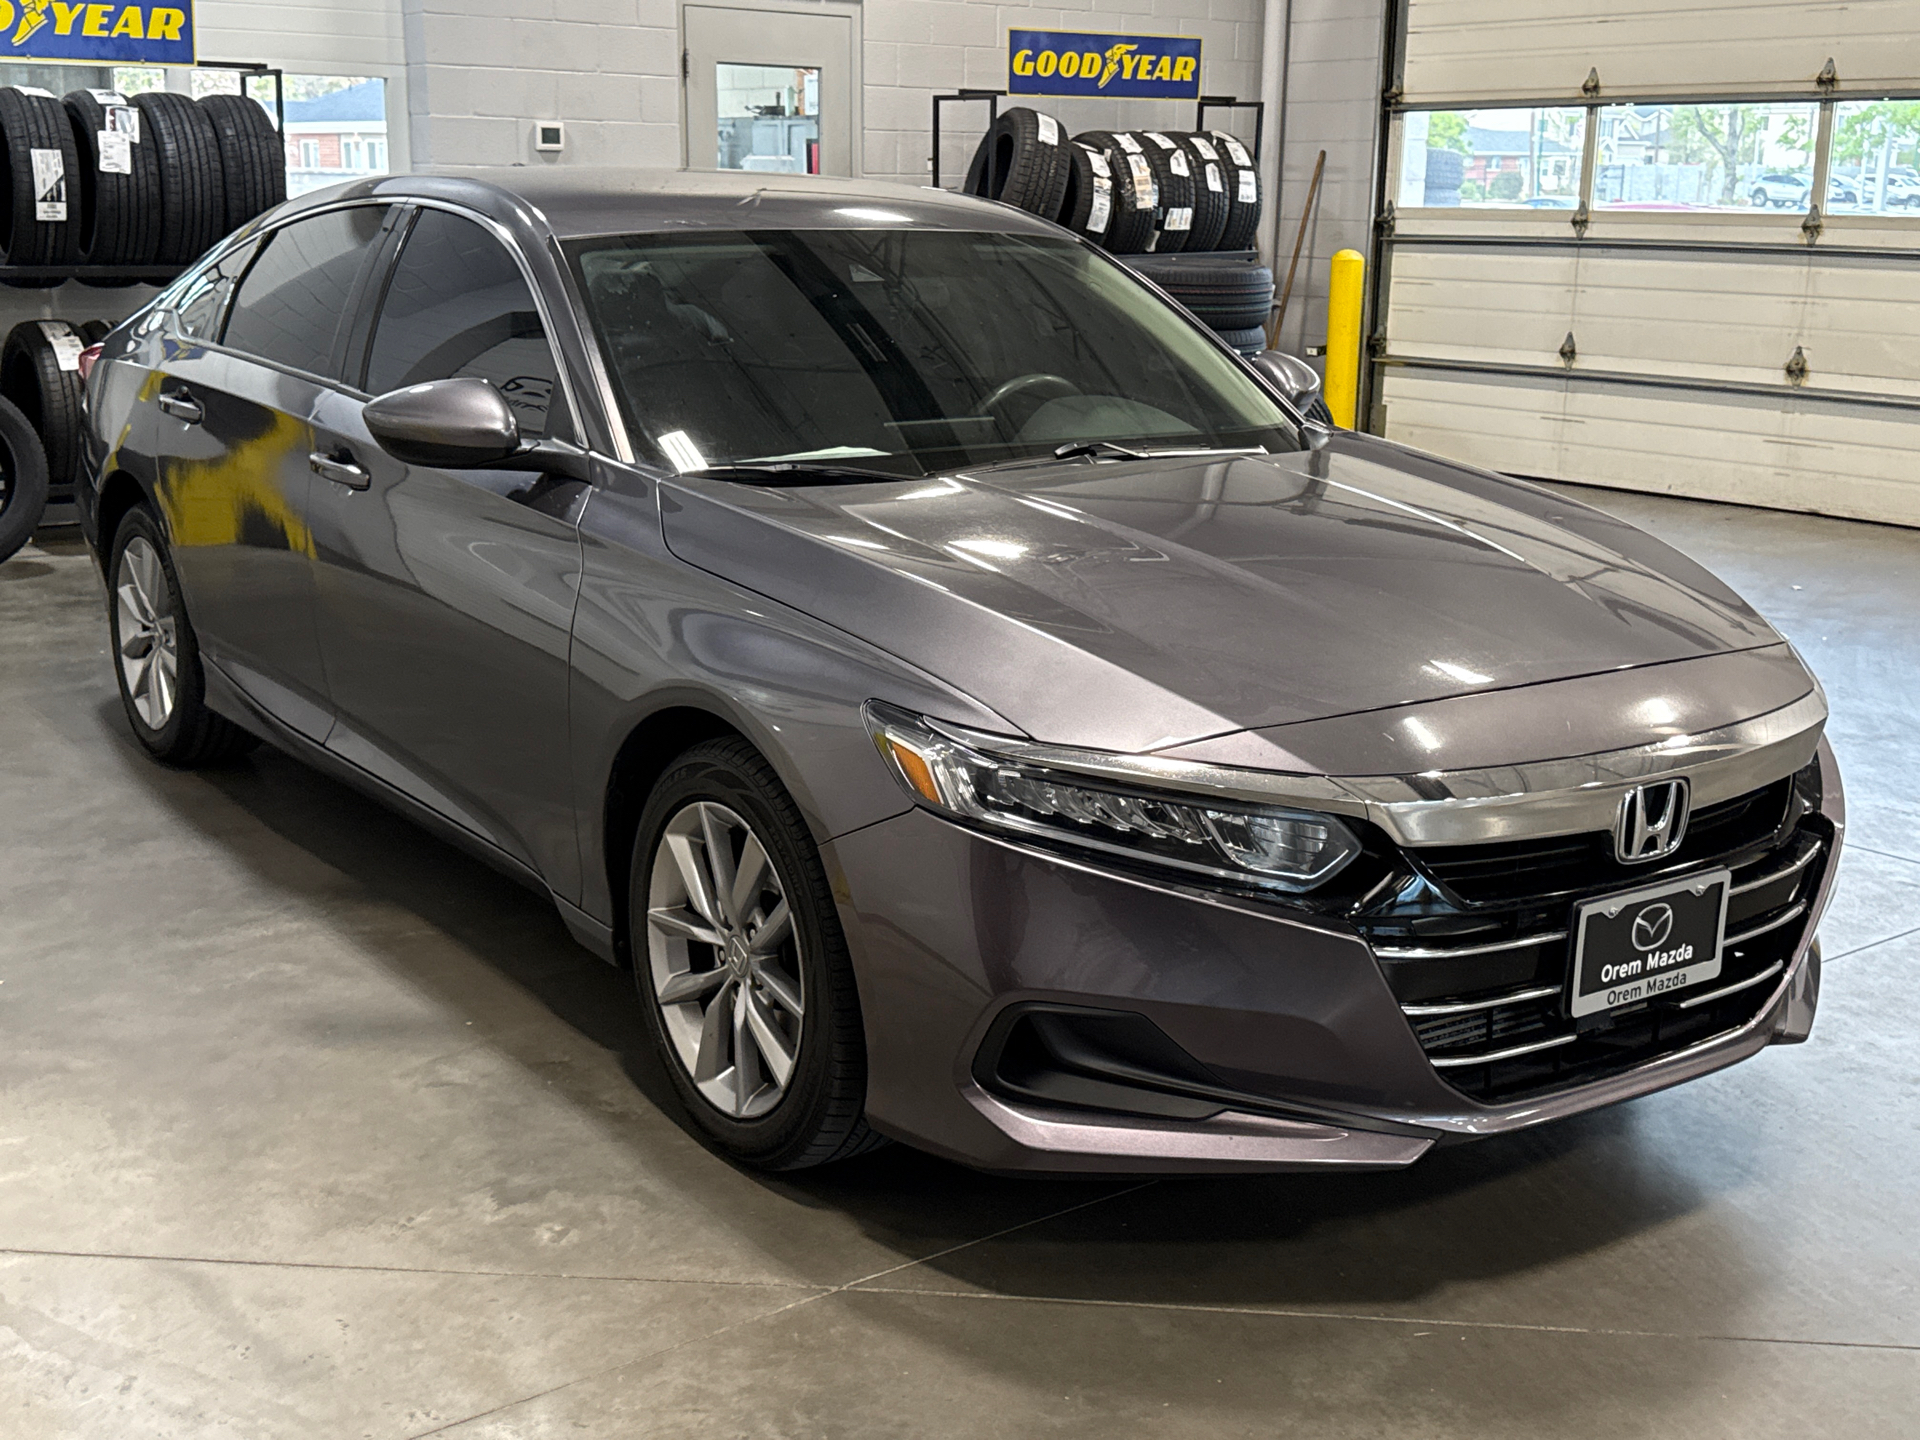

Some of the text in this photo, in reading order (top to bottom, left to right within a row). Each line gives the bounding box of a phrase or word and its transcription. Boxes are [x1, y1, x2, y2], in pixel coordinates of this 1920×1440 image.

[1601, 943, 1694, 983] Orem Mazda
[1607, 972, 1687, 1006] Orem Mazda
